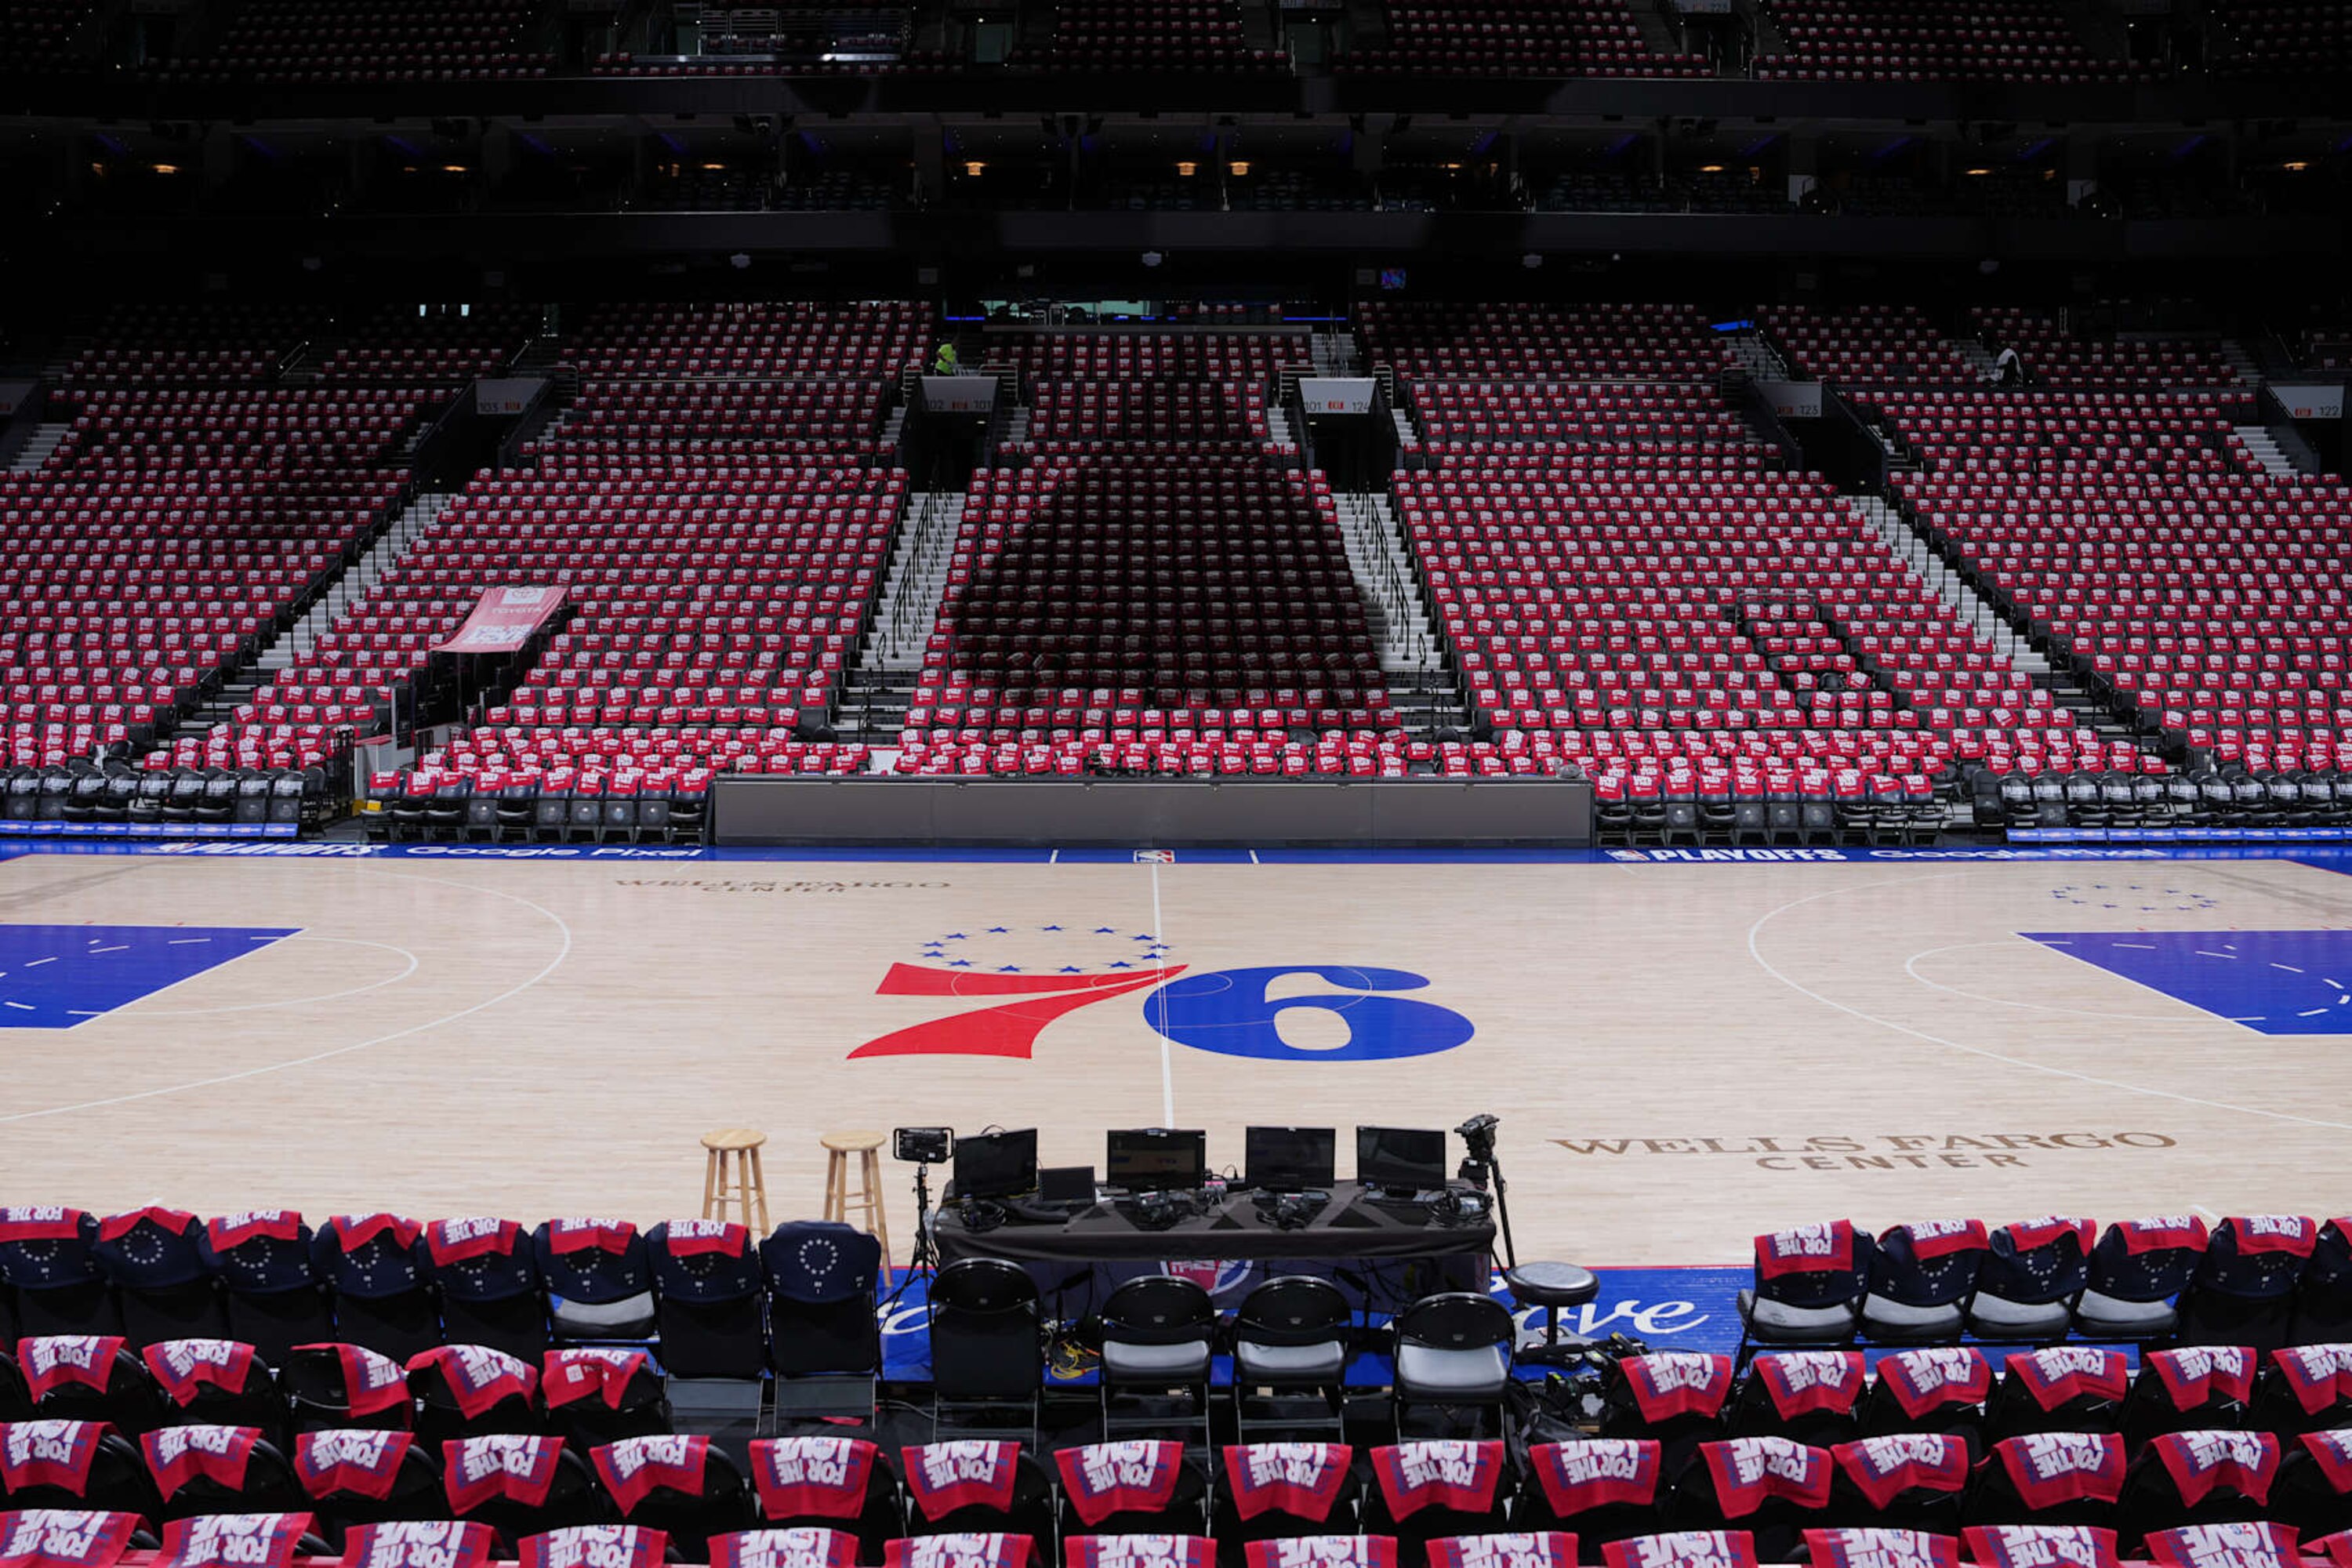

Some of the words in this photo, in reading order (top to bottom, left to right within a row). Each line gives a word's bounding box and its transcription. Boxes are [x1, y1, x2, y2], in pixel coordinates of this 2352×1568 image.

[1305, 401, 1322, 412] 101
[2319, 406, 2339, 416] 122
[407, 847, 580, 856] Google
[591, 848, 703, 856] Pixel
[1650, 849, 1848, 860] PLAYOFFS
[847, 962, 1474, 1061] 76
[1547, 1135, 1867, 1154] WELLS
[1877, 1131, 2180, 1150] FARGO
[1756, 1154, 2034, 1171] CENTER
[19, 1509, 111, 1534] LOVE
[191, 1513, 284, 1541] LOVE
[373, 1521, 466, 1548] LOVE
[550, 1525, 638, 1551] LOVE
[739, 1528, 832, 1557] LOVE
[912, 1534, 1004, 1562] LOVE
[1098, 1535, 1187, 1562] LOVE
[1278, 1535, 1368, 1565] LOVE
[1459, 1532, 1550, 1557] LOVE
[1637, 1530, 1730, 1566] LOVE
[1842, 1528, 1933, 1556] LOVE
[1998, 1526, 2093, 1548] LOVE
[2182, 1522, 2276, 1555] LOVE
